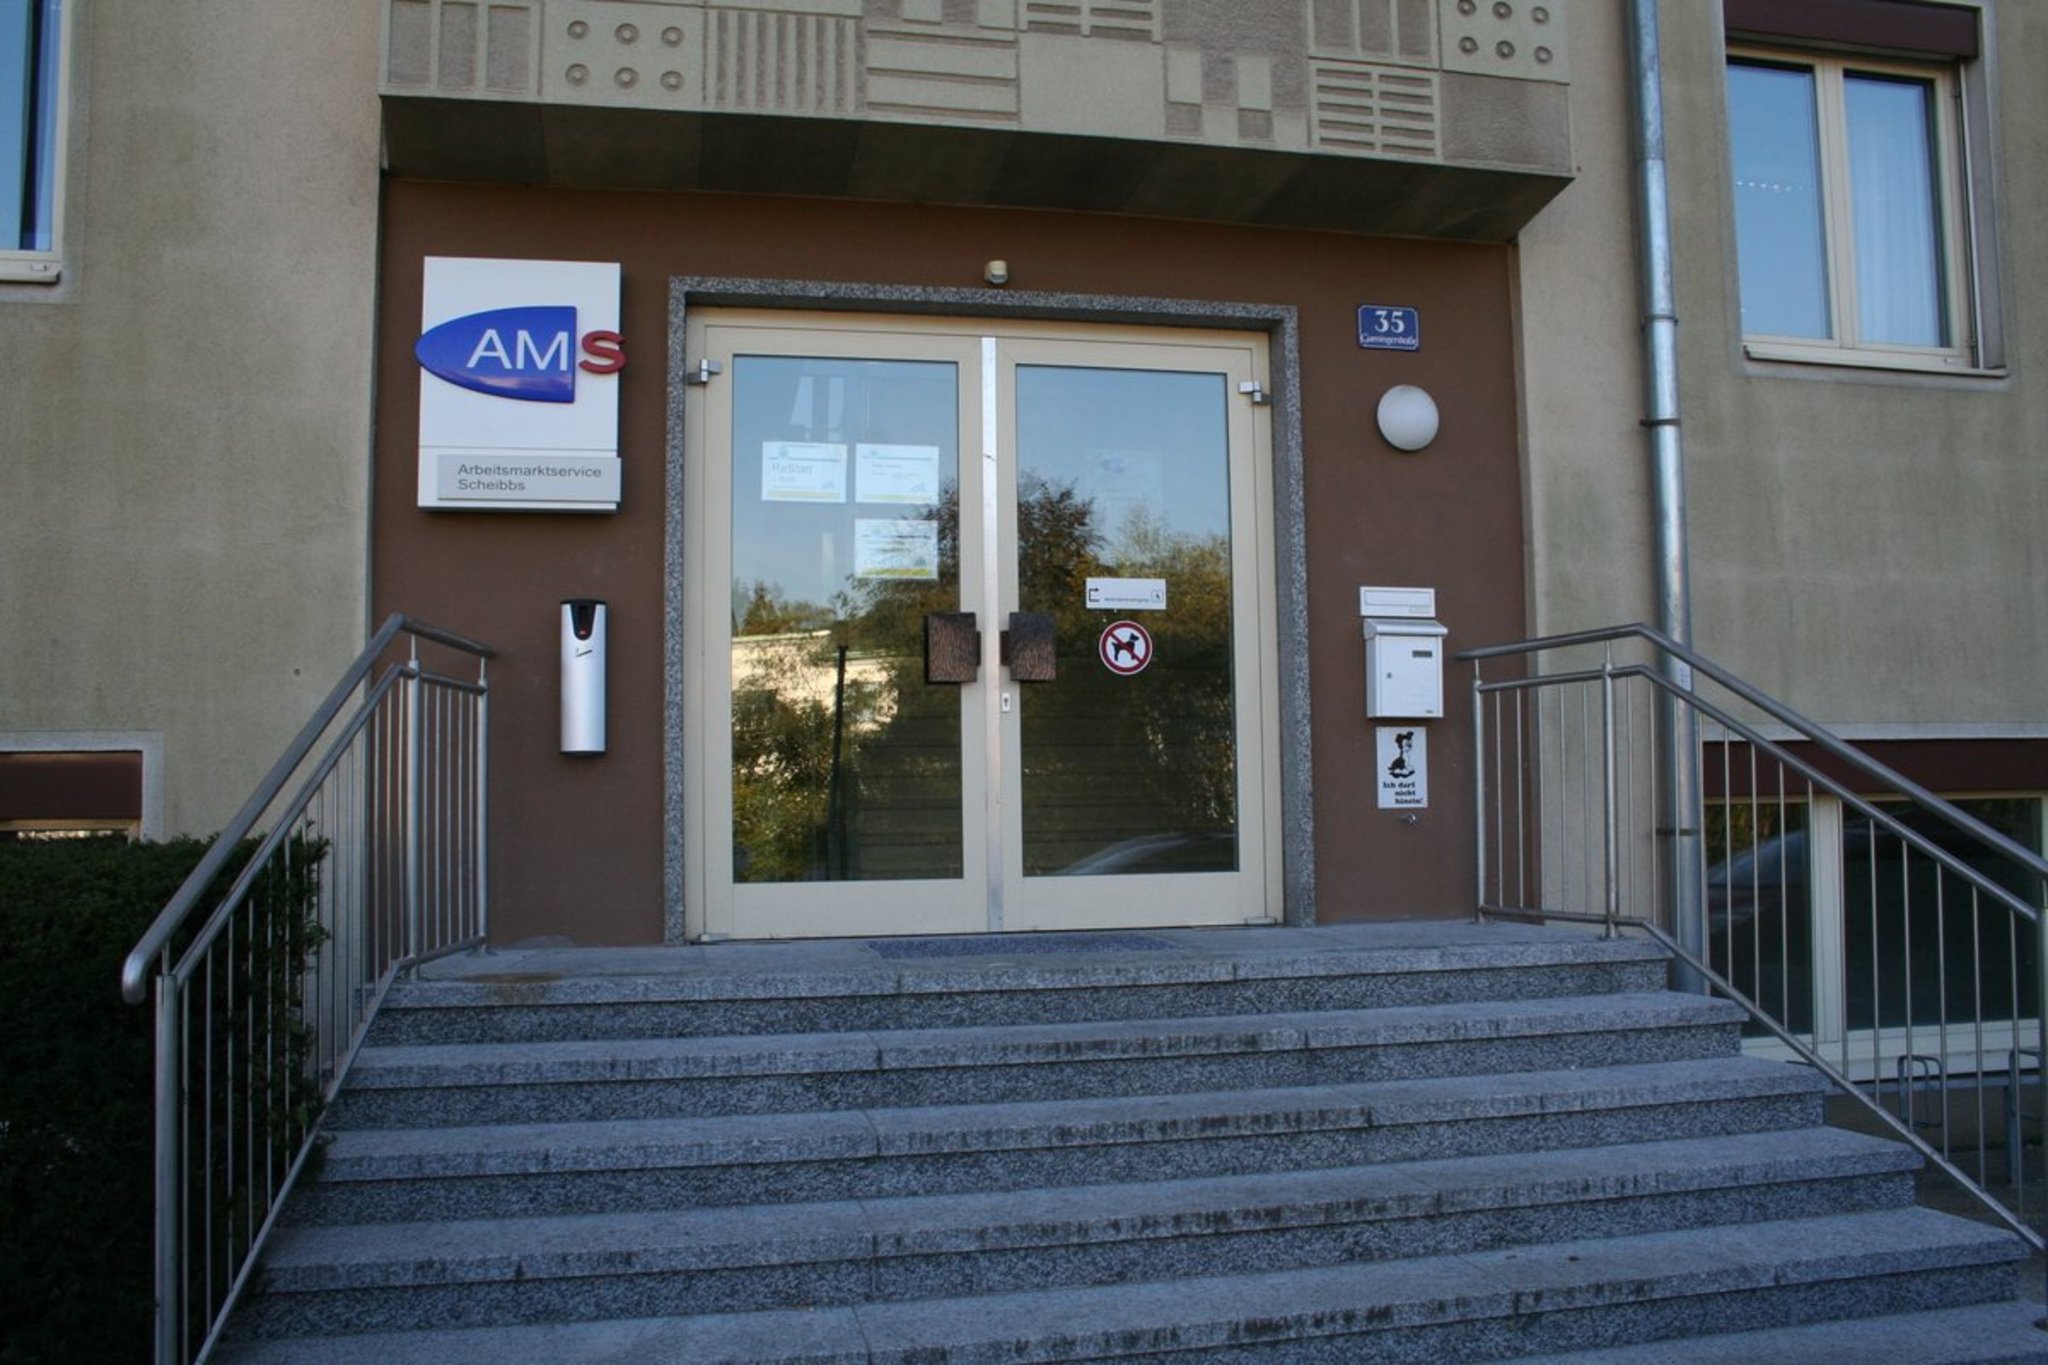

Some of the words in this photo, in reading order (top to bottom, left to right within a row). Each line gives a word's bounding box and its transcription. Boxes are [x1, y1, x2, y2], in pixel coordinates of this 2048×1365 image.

[1374, 310, 1405, 334] 35
[466, 328, 627, 375] AMS
[457, 463, 602, 478] Arbeitsmarktservice
[458, 478, 526, 491] Scheibbs
[1383, 781, 1396, 789] Ich
[1398, 781, 1416, 789] darf
[1394, 789, 1416, 797] nicht
